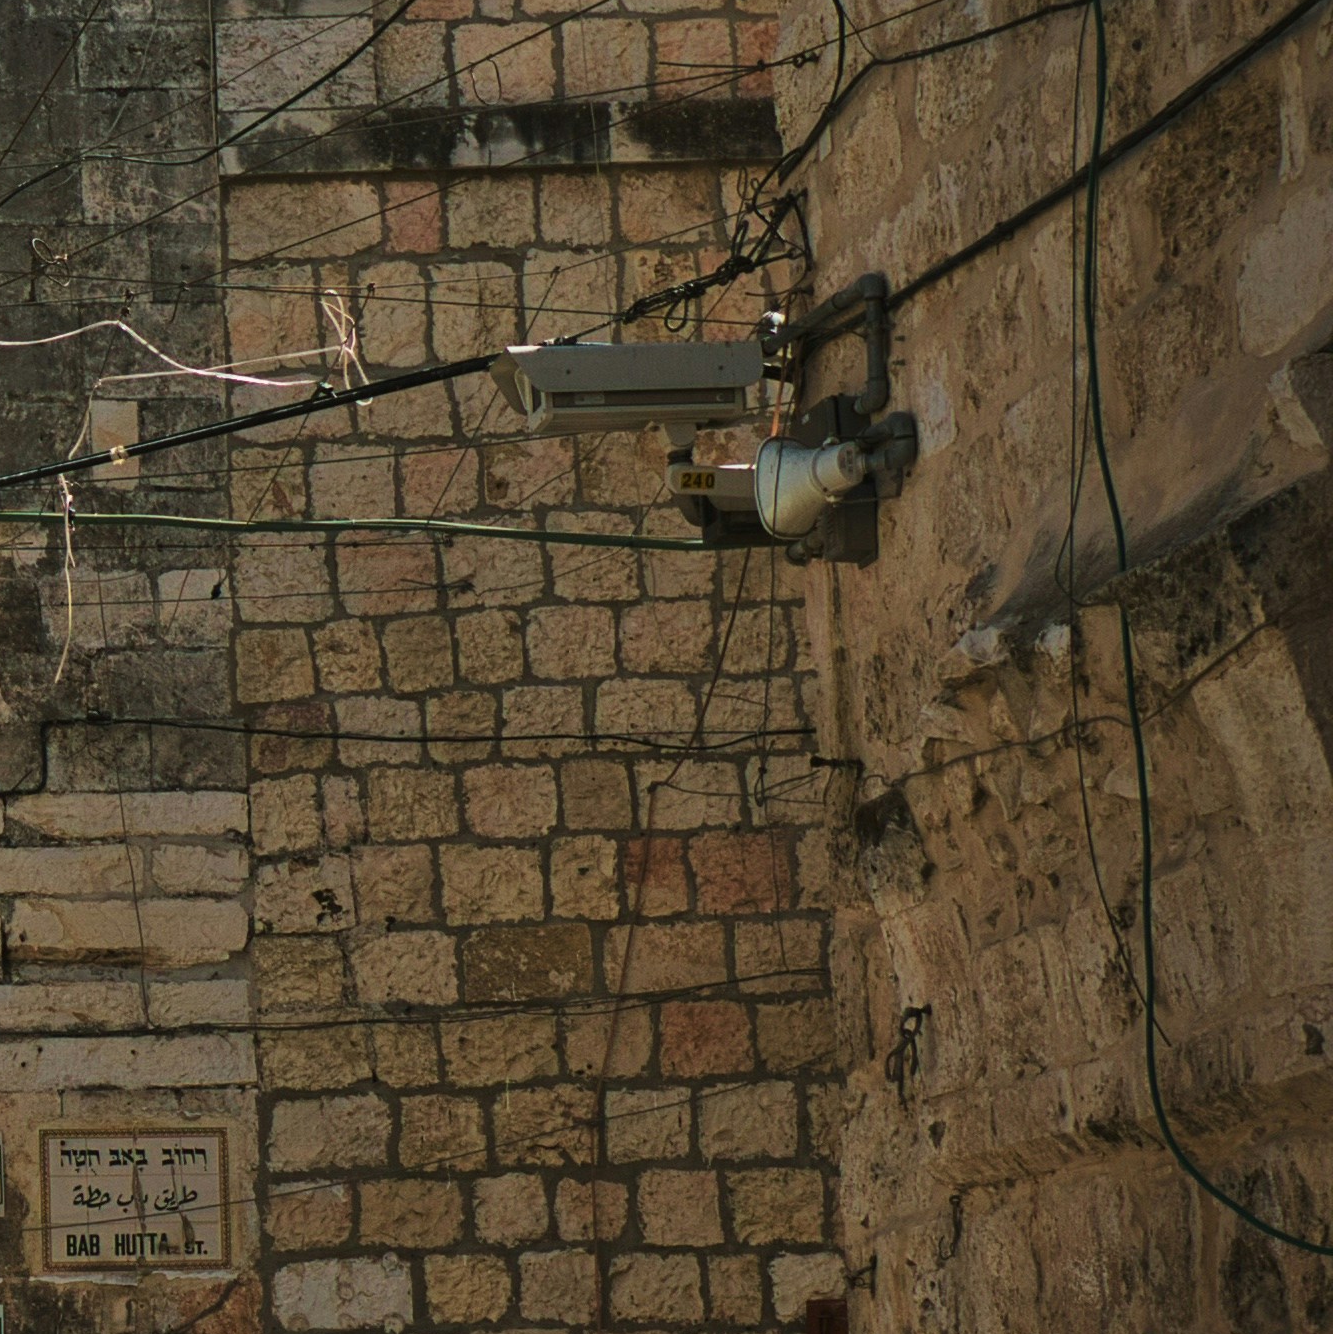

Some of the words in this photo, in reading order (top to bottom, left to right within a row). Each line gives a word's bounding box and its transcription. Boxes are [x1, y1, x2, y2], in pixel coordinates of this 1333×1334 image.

[682, 472, 715, 489] 240
[154, 1184, 198, 1211] طريق
[66, 1234, 101, 1257] BAB
[114, 1233, 170, 1257] HUTTA
